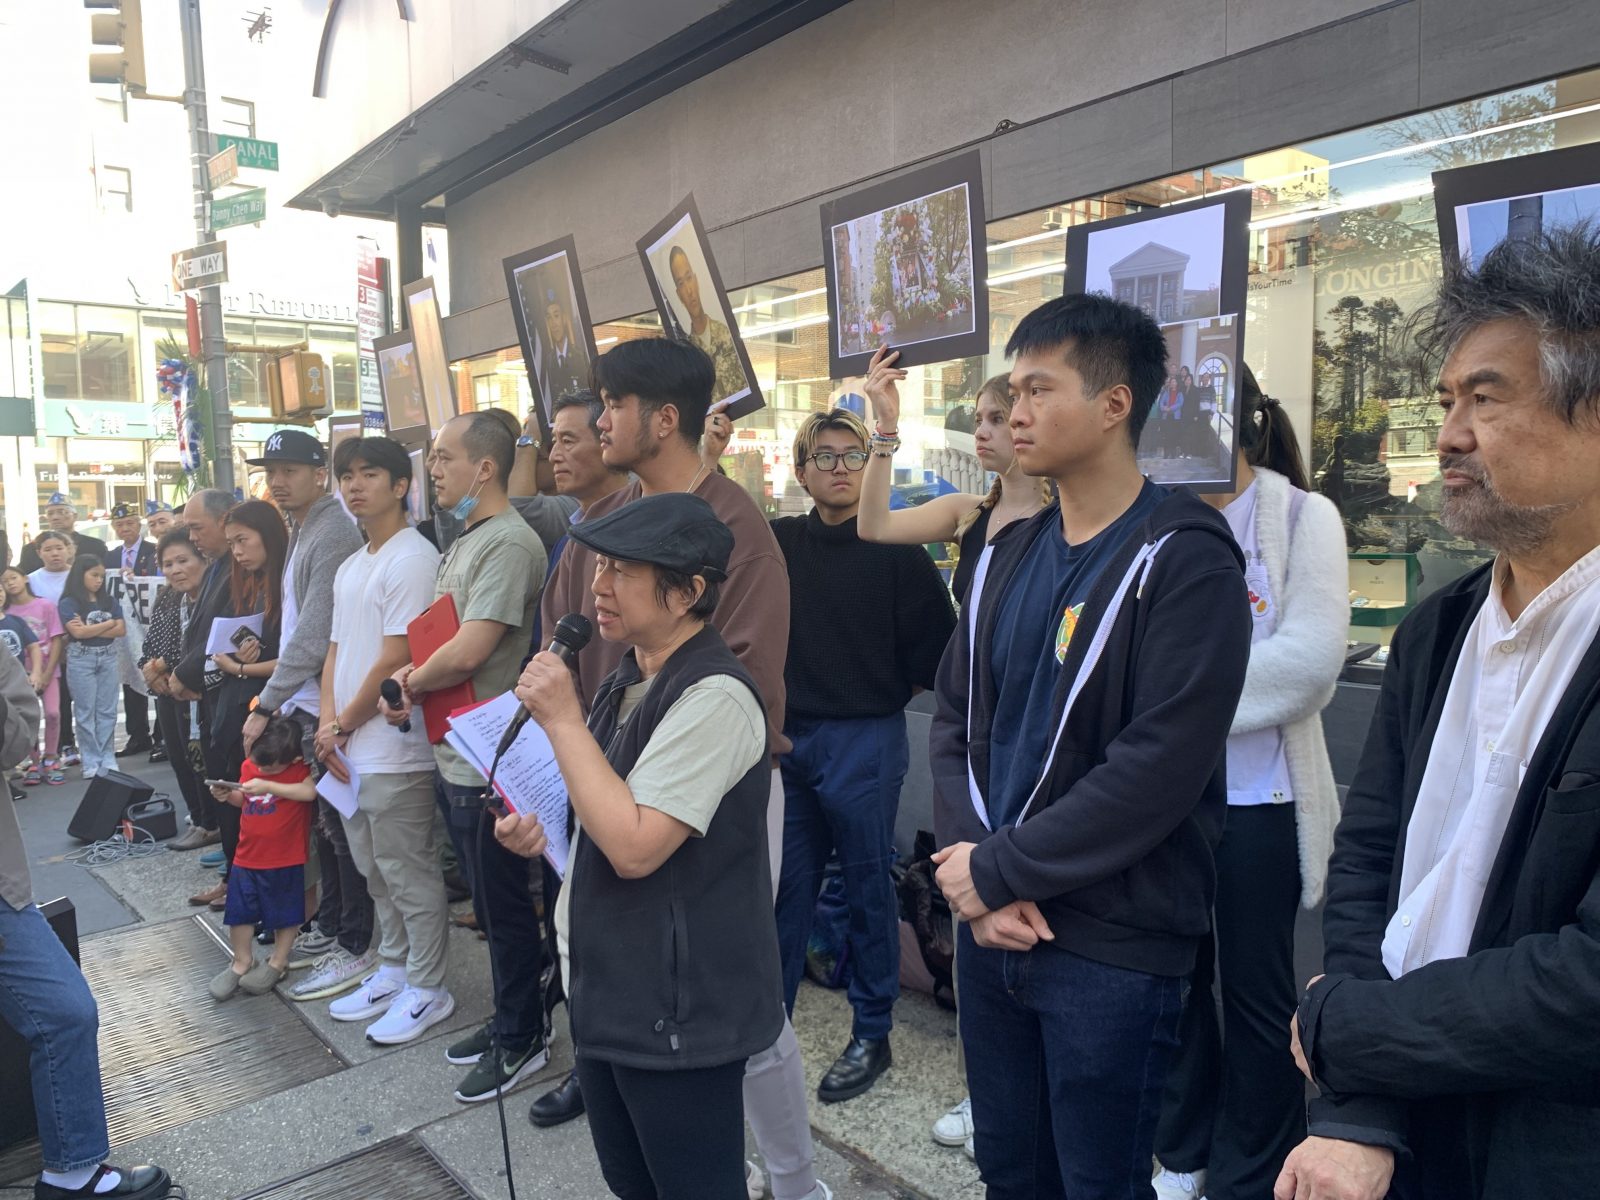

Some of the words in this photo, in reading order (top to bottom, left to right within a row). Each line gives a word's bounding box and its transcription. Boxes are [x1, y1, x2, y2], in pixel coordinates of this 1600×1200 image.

[232, 204, 249, 217] Chen
[250, 200, 264, 215] Way
[177, 261, 193, 279] ONE
[200, 254, 220, 274] WAY
[249, 291, 358, 322] REPUBLI
[267, 434, 283, 451] NY
